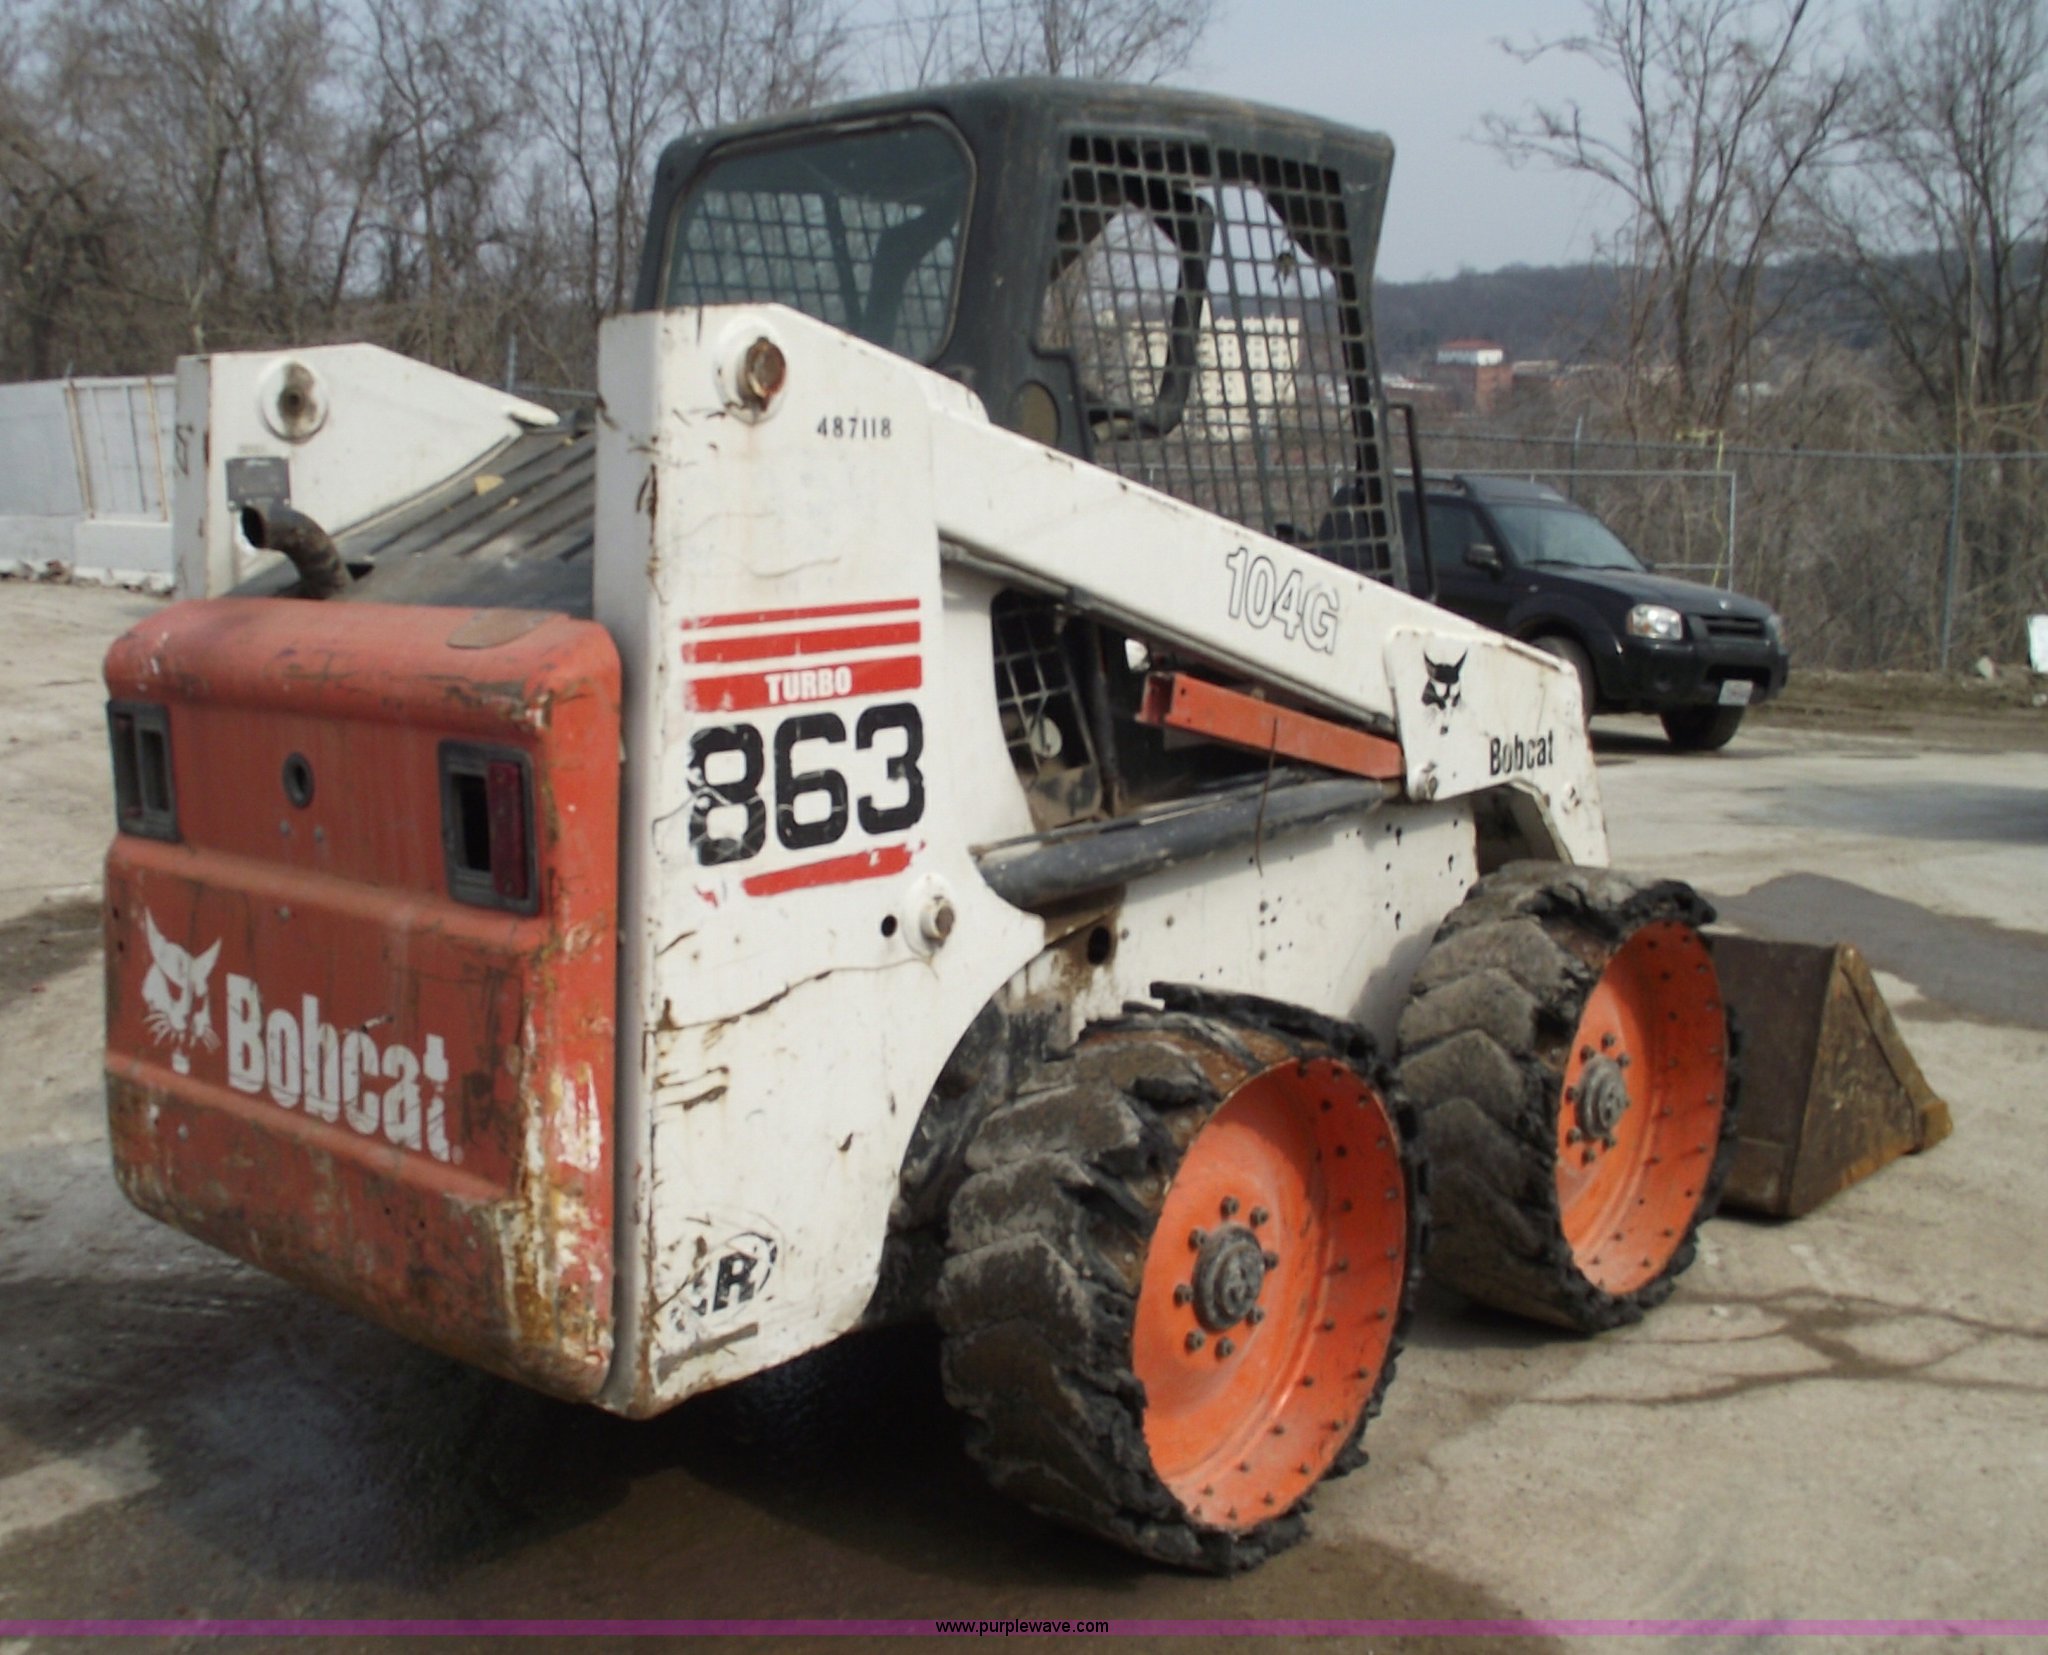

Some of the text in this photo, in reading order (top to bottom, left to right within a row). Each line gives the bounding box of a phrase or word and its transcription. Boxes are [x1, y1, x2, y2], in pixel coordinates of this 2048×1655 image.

[817, 415, 891, 439] 487118
[1226, 547, 1339, 655] 104G
[764, 666, 853, 705] TURBO
[687, 702, 925, 866] 863
[1489, 730, 1554, 776] Bobcat
[226, 972, 450, 1163] Bobcat
